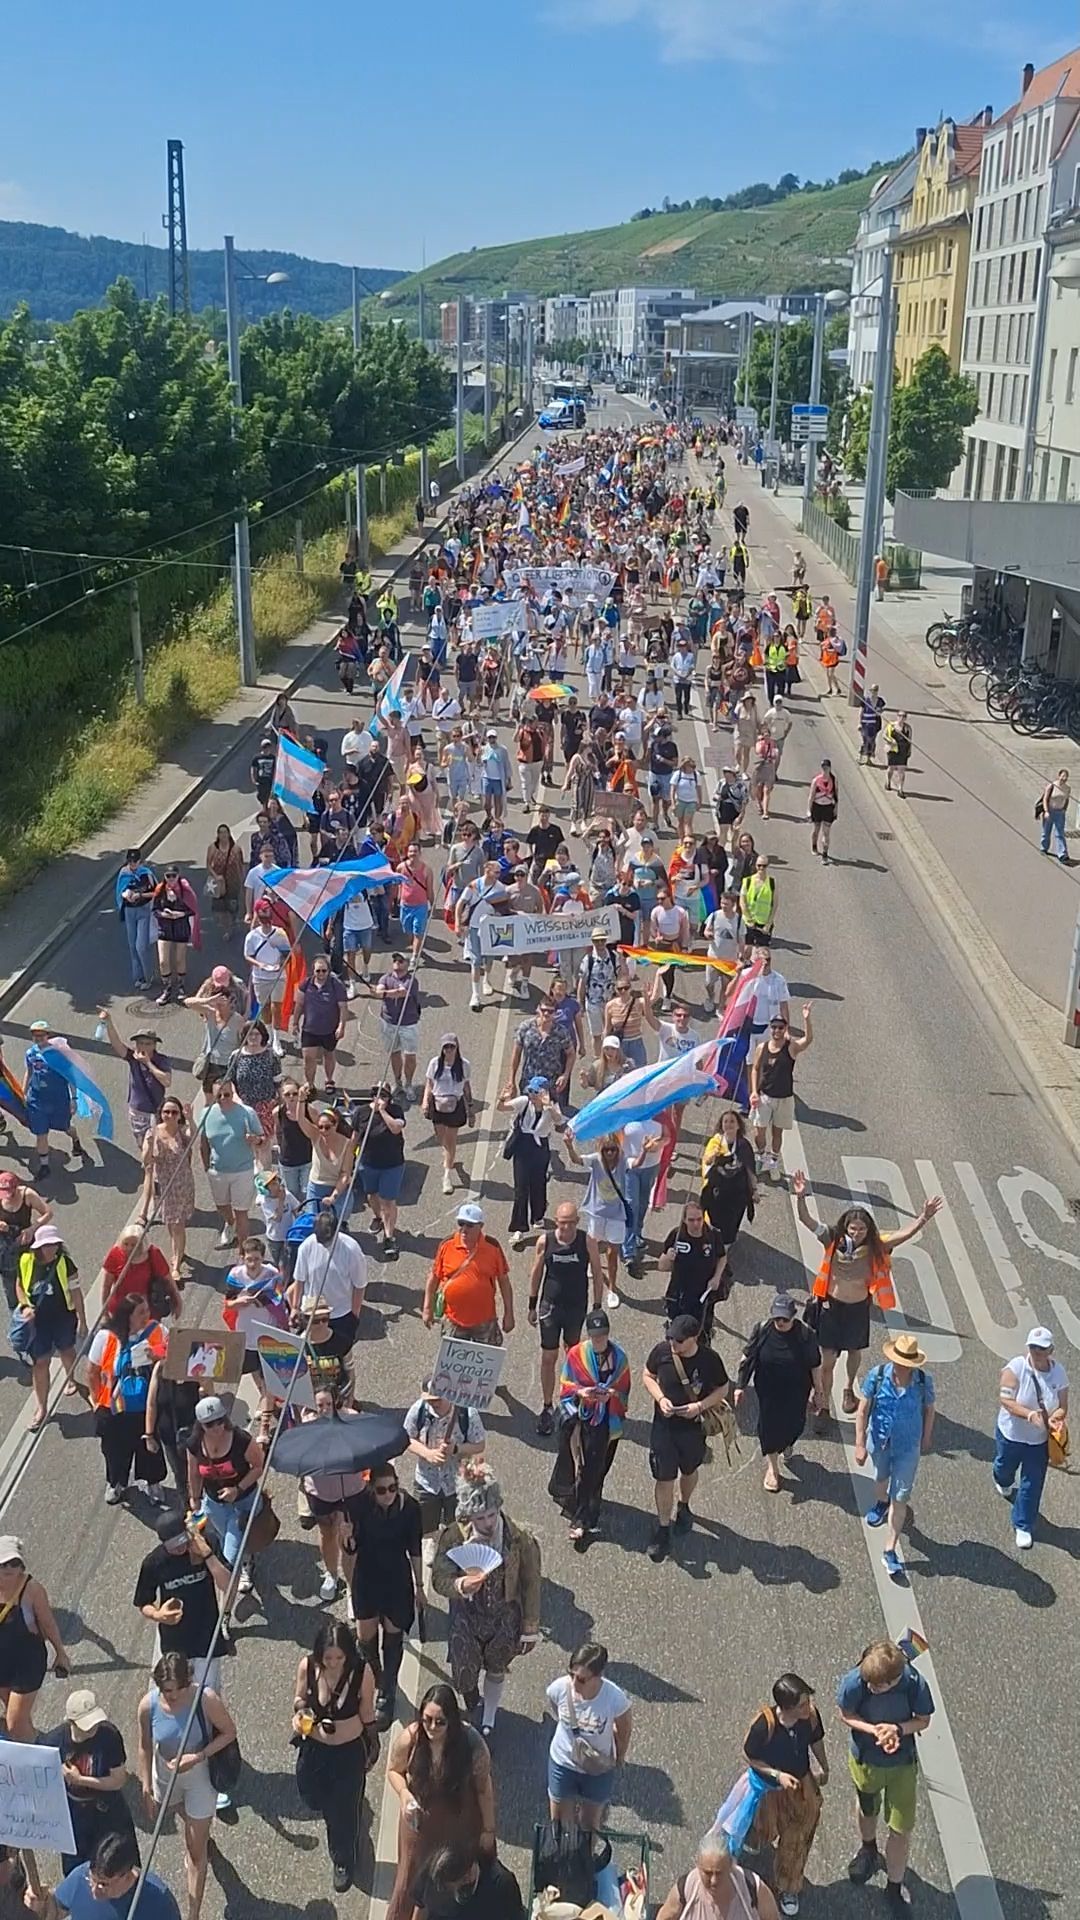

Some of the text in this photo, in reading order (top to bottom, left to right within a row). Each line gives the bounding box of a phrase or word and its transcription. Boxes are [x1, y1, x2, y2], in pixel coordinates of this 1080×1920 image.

[524, 913, 611, 934] WEISSENBURG
[841, 1156, 1080, 1363] BUS
[440, 1360, 494, 1377] woman
